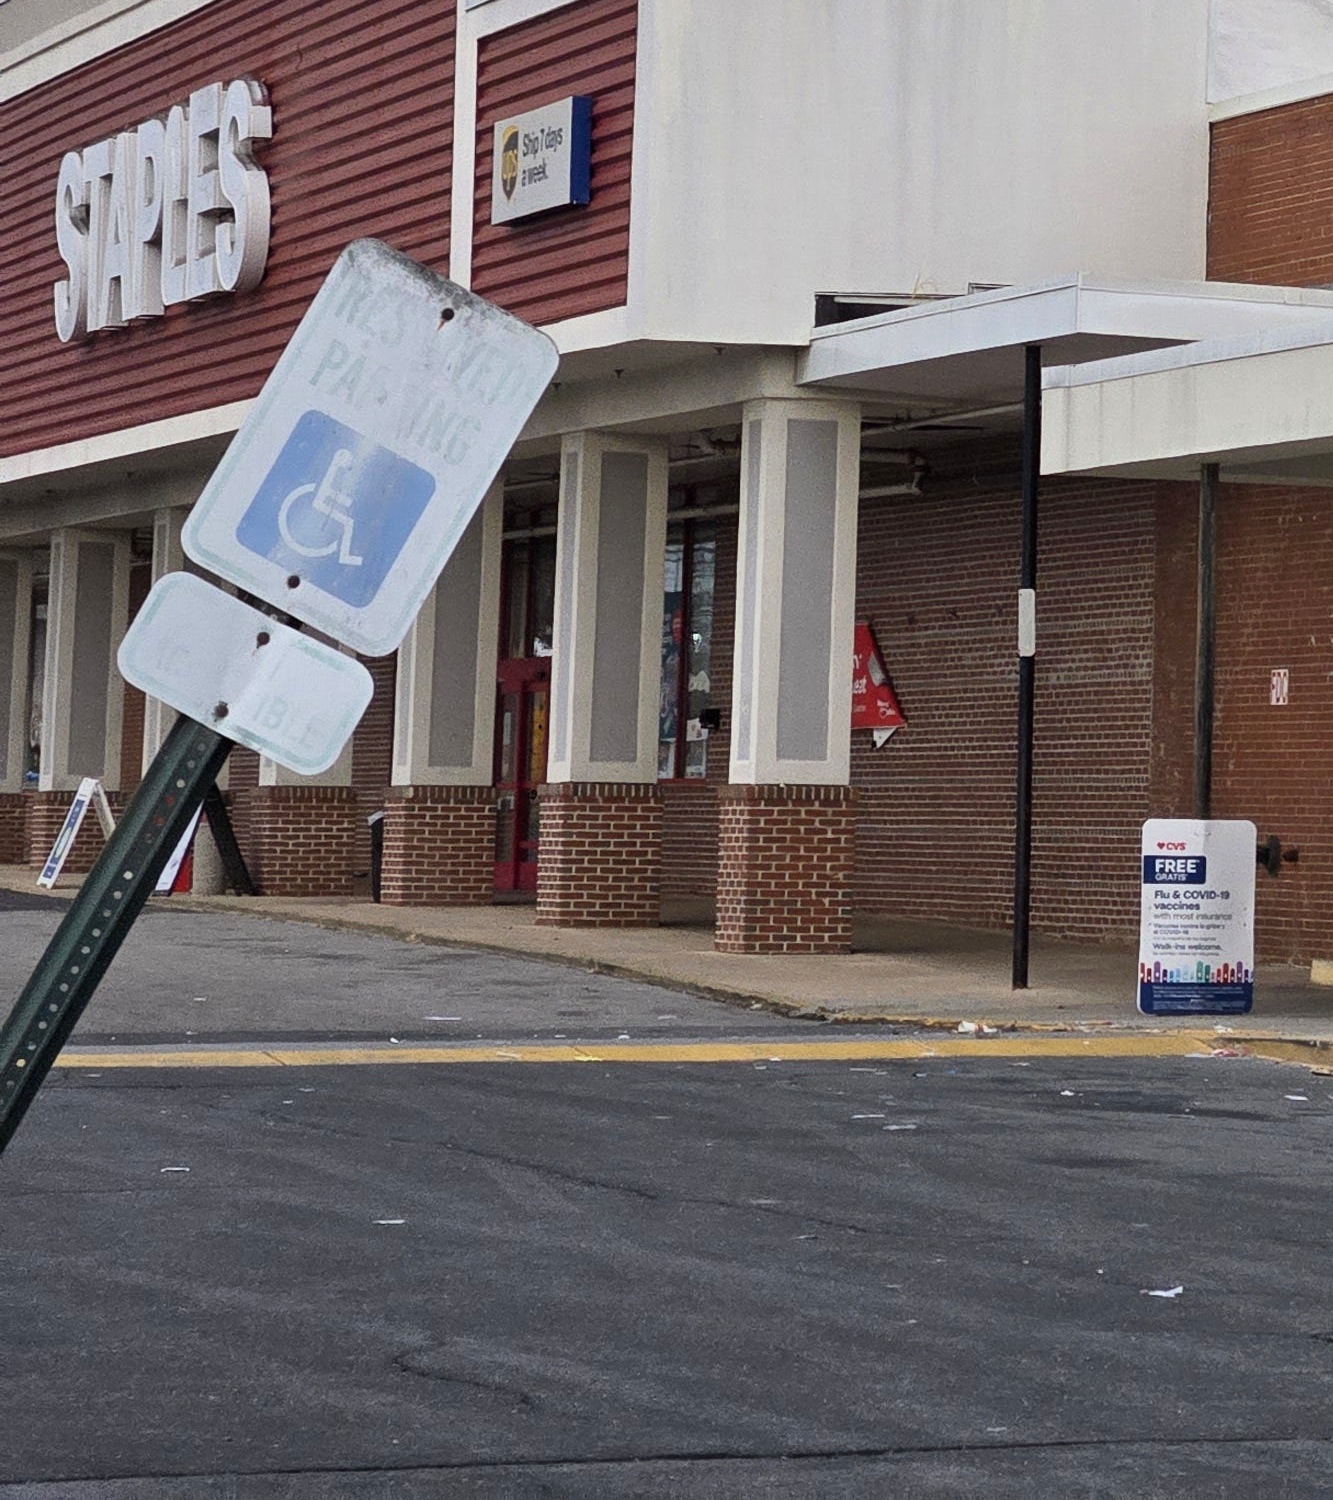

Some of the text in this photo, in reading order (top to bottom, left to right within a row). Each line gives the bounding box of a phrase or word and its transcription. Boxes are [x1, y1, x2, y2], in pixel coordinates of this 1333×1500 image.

[522, 126, 563, 159] Ship 7 days
[54, 79, 271, 342] STAPLES
[330, 264, 535, 413] RESVED
[305, 337, 486, 471] PAING
[1166, 842, 1187, 851] CVS
[1154, 890, 1230, 900] Flu & COVID-19
[1154, 900, 1200, 911] vaccines
